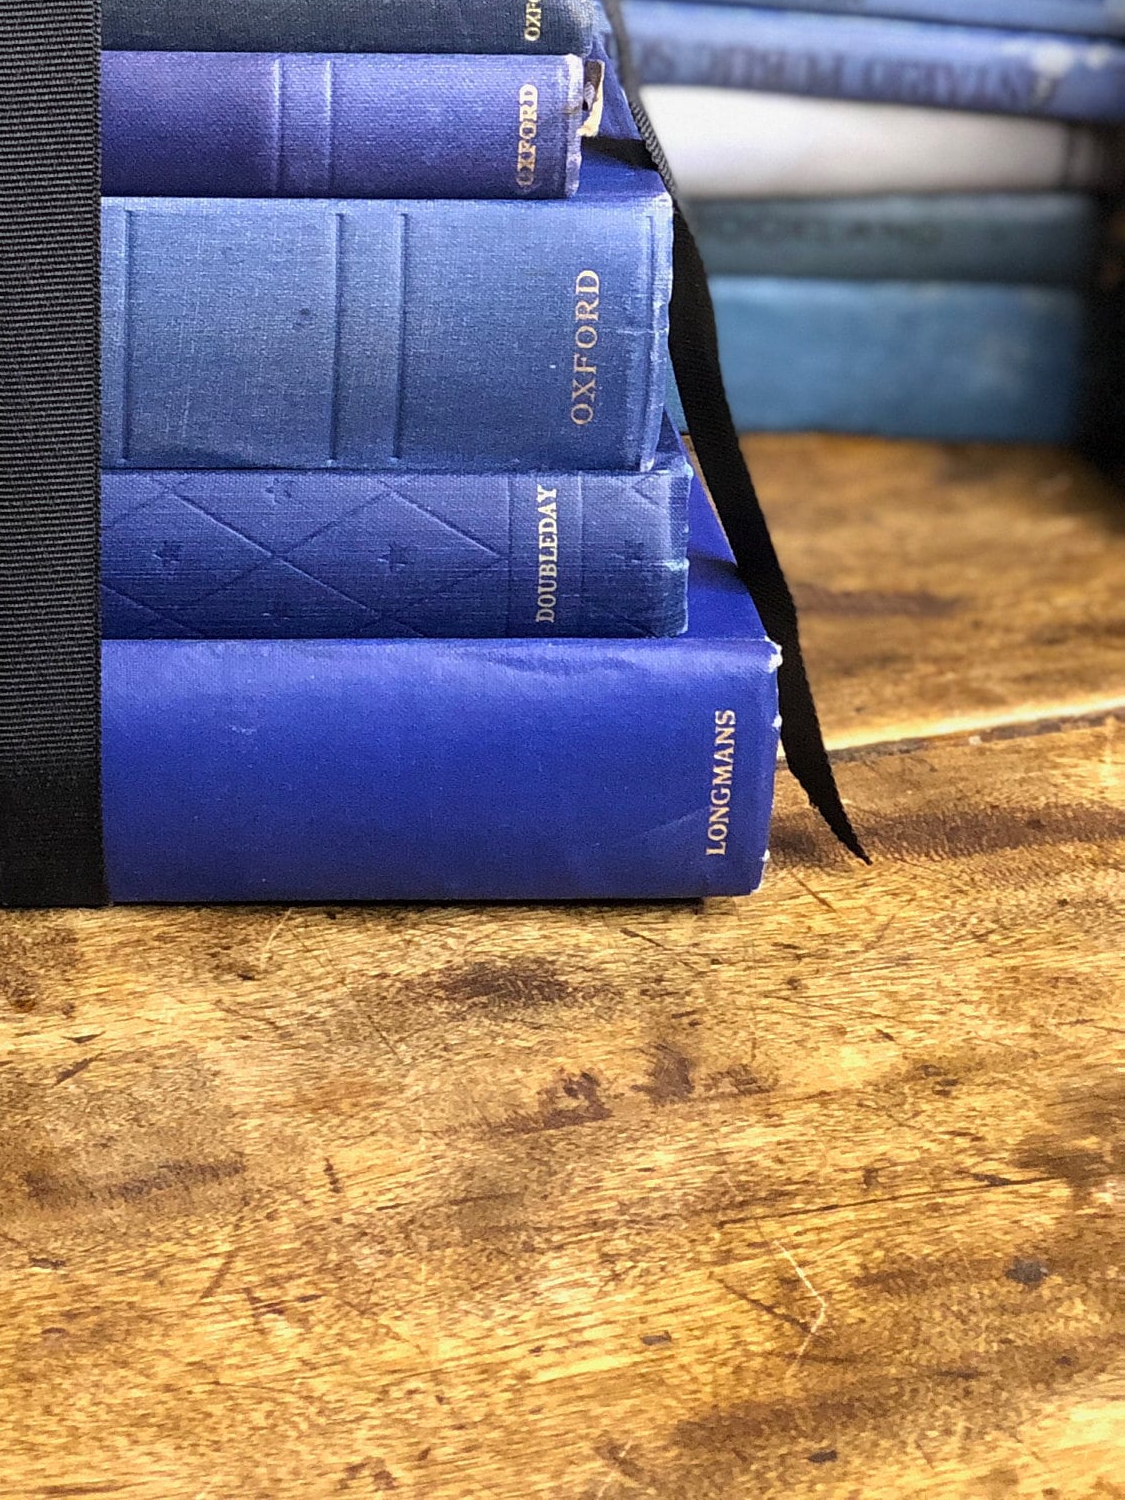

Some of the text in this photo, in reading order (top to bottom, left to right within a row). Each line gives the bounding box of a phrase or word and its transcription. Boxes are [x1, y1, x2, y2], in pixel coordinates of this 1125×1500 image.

[516, 84, 539, 188] OXFORD
[571, 268, 601, 427] OXFORD
[535, 484, 559, 624] DOUBLEDAY
[706, 708, 737, 857] LONGMANS
